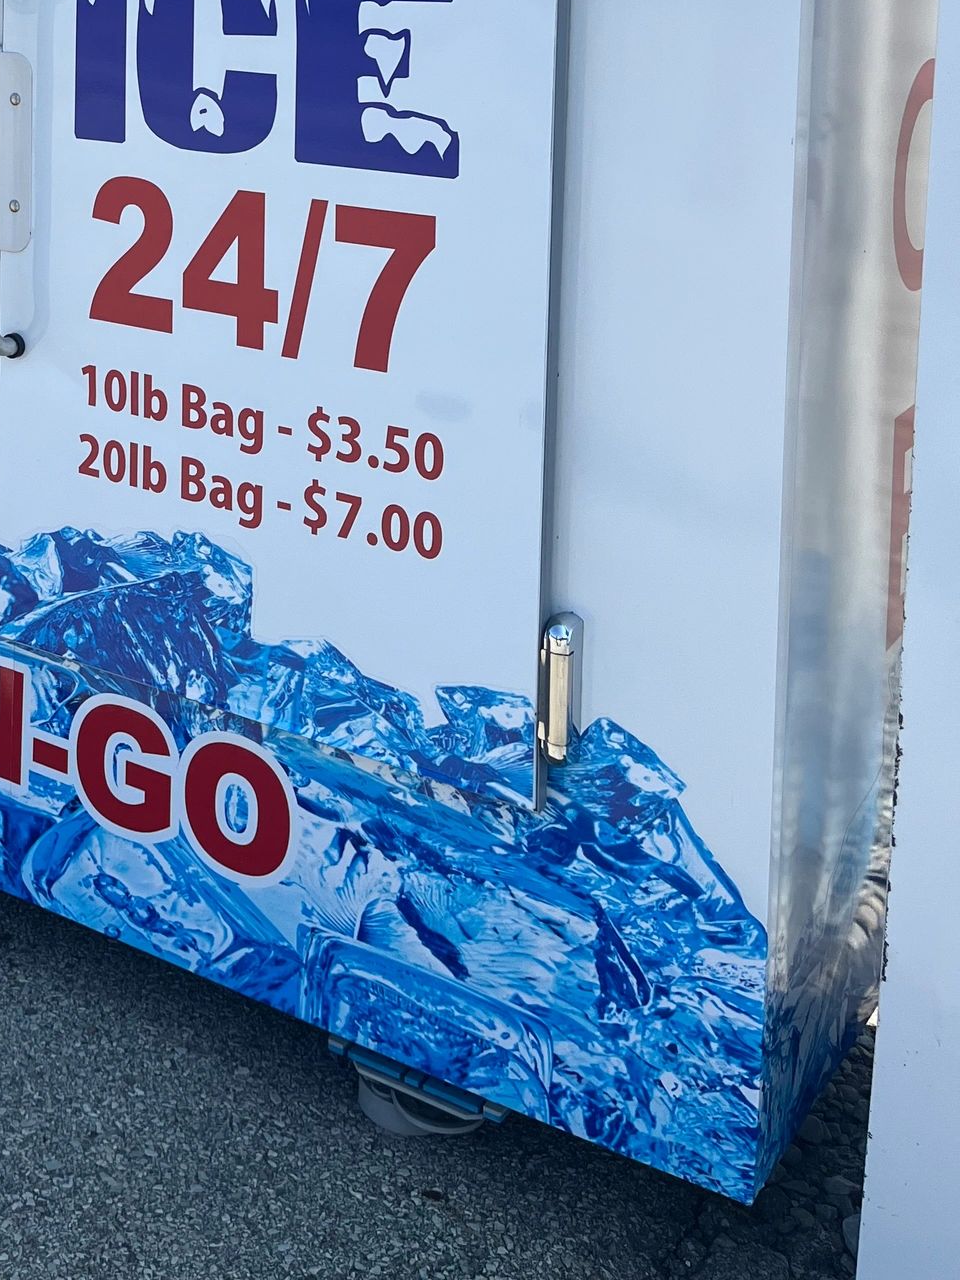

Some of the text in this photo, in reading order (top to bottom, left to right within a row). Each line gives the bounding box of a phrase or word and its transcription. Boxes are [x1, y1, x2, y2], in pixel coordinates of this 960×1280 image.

[89, 176, 437, 373] 24/7
[81, 364, 168, 422] 10lb
[182, 384, 264, 455] Bag
[307, 406, 443, 481] $3.50
[78, 434, 167, 494] 20lb
[181, 457, 263, 529] Bag
[303, 480, 442, 560] $7.00
